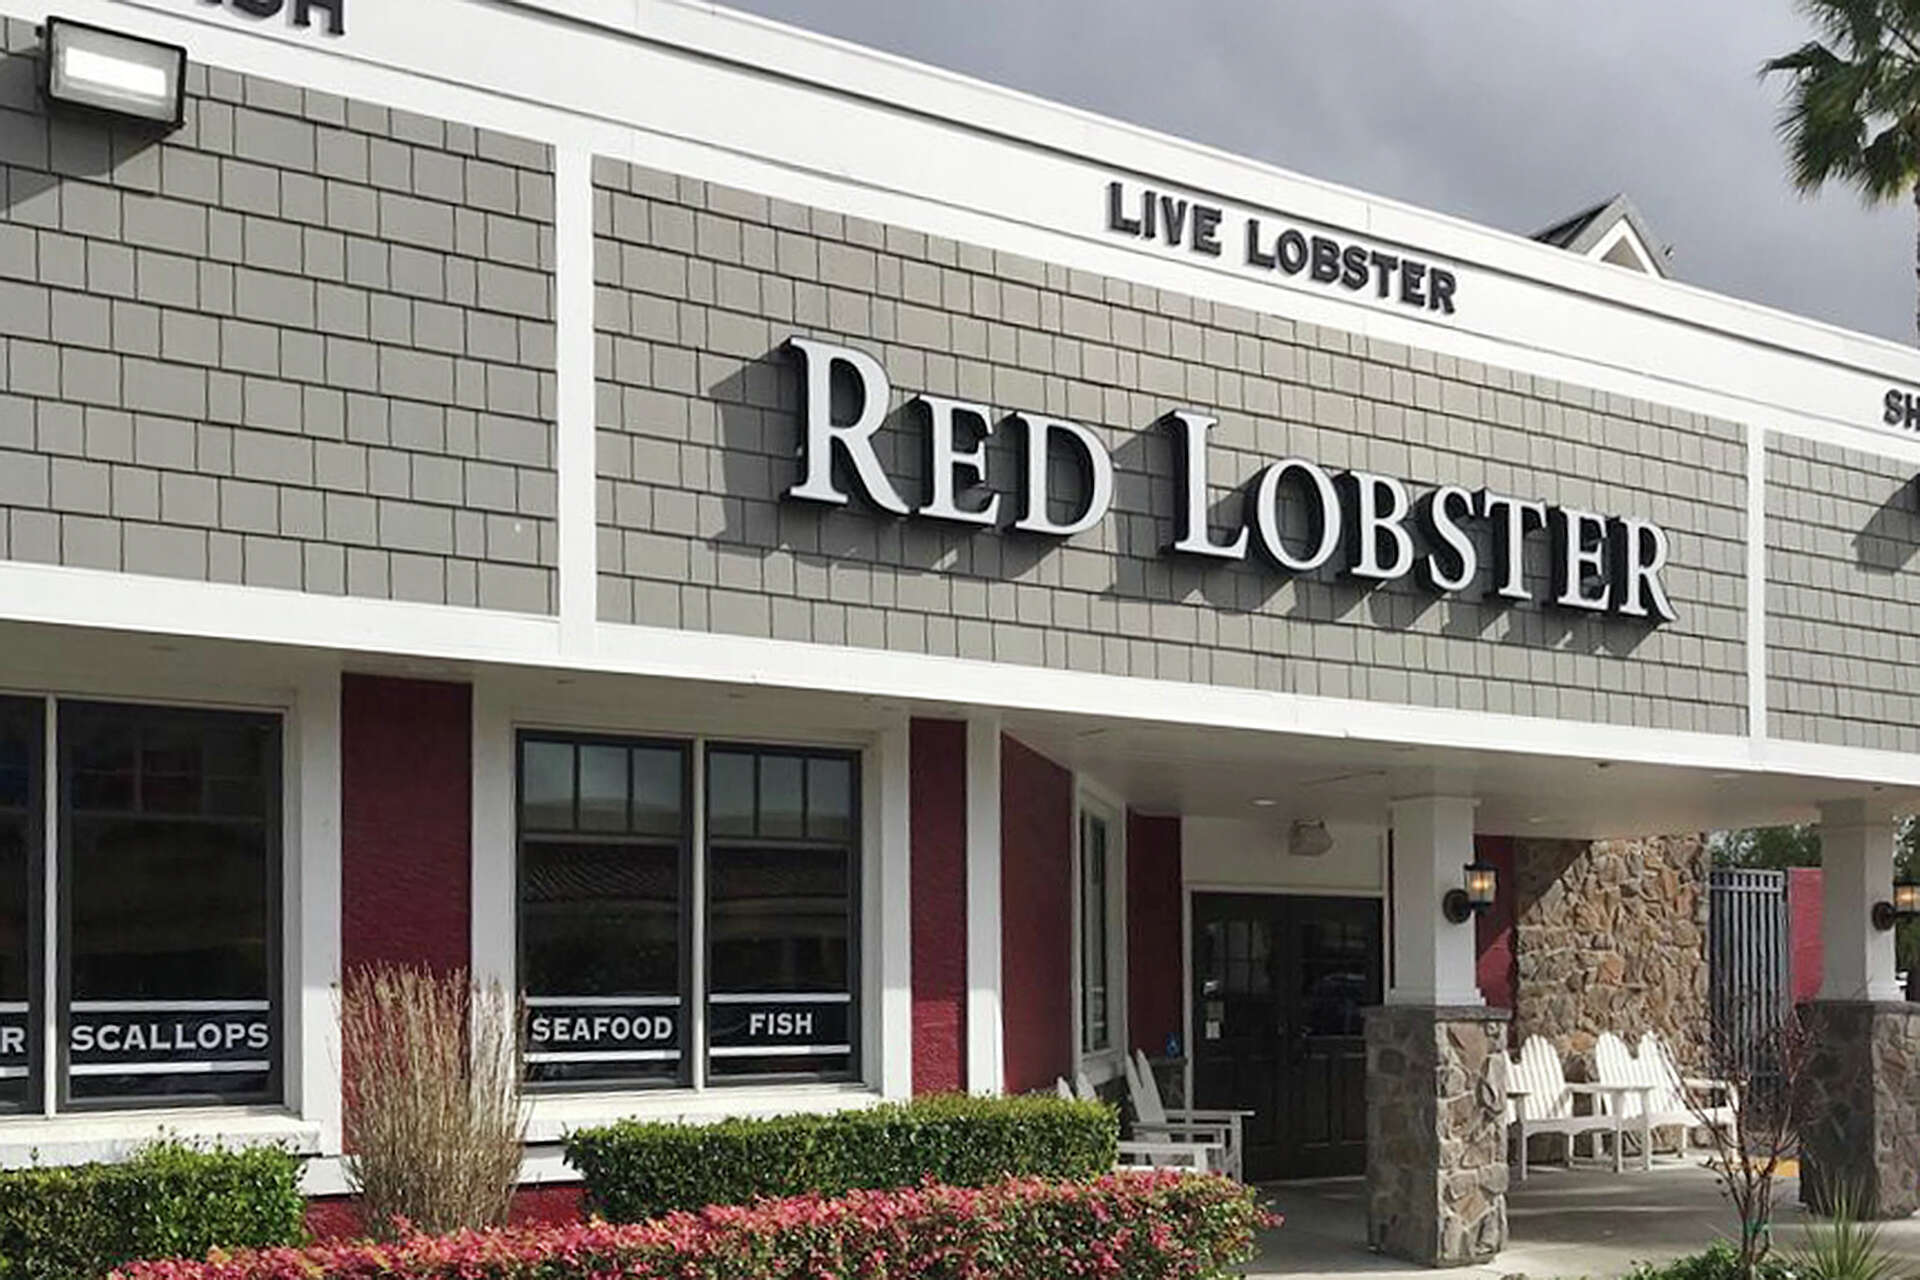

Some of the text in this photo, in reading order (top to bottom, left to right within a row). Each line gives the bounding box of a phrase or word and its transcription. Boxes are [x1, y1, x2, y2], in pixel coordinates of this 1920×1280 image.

[1108, 181, 1457, 315] LIVE LOBSTER
[786, 336, 1678, 624] RED LOBSTER
[70, 1023, 270, 1051] SCALLOPS
[531, 1016, 674, 1041] SEAFOOD
[749, 1012, 814, 1036] FISH
